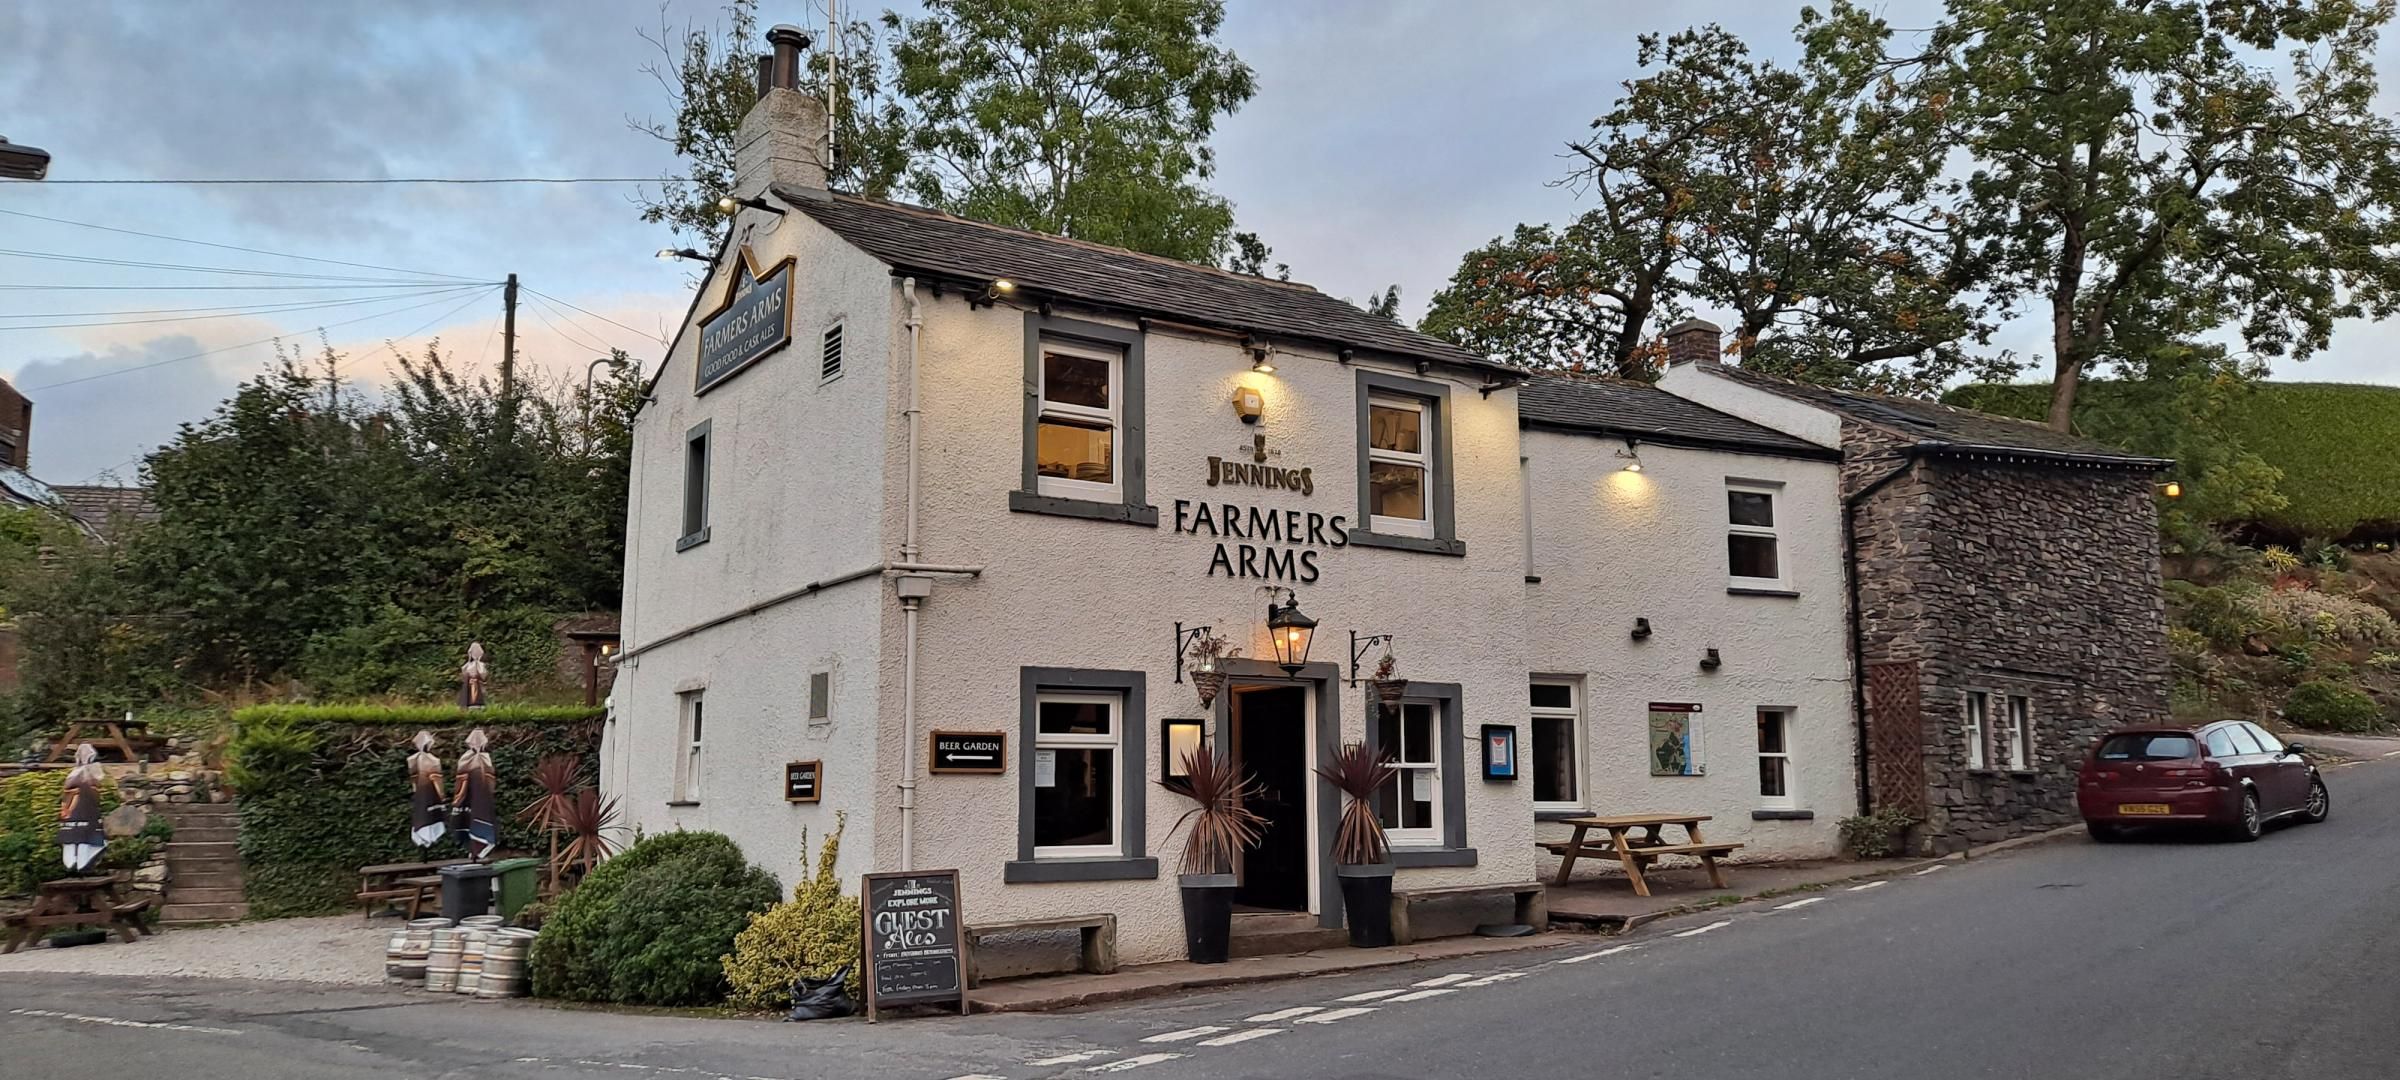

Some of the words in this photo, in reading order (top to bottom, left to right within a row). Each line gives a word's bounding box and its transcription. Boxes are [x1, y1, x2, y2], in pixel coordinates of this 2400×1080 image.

[703, 311, 748, 358] FARMERS
[749, 287, 782, 328] ARMS
[704, 359, 722, 378] GOOD
[721, 349, 738, 368] FOOD
[743, 334, 760, 355] CASK
[760, 323, 775, 343] ALES
[1207, 455, 1314, 496] JENNINGS
[1174, 499, 1349, 547] FARMERS
[1207, 543, 1319, 583] ARMS
[939, 742, 961, 751] BEER
[962, 742, 1000, 751] GARDEN
[875, 908, 950, 935] GUEST
[885, 924, 937, 949] Ales
